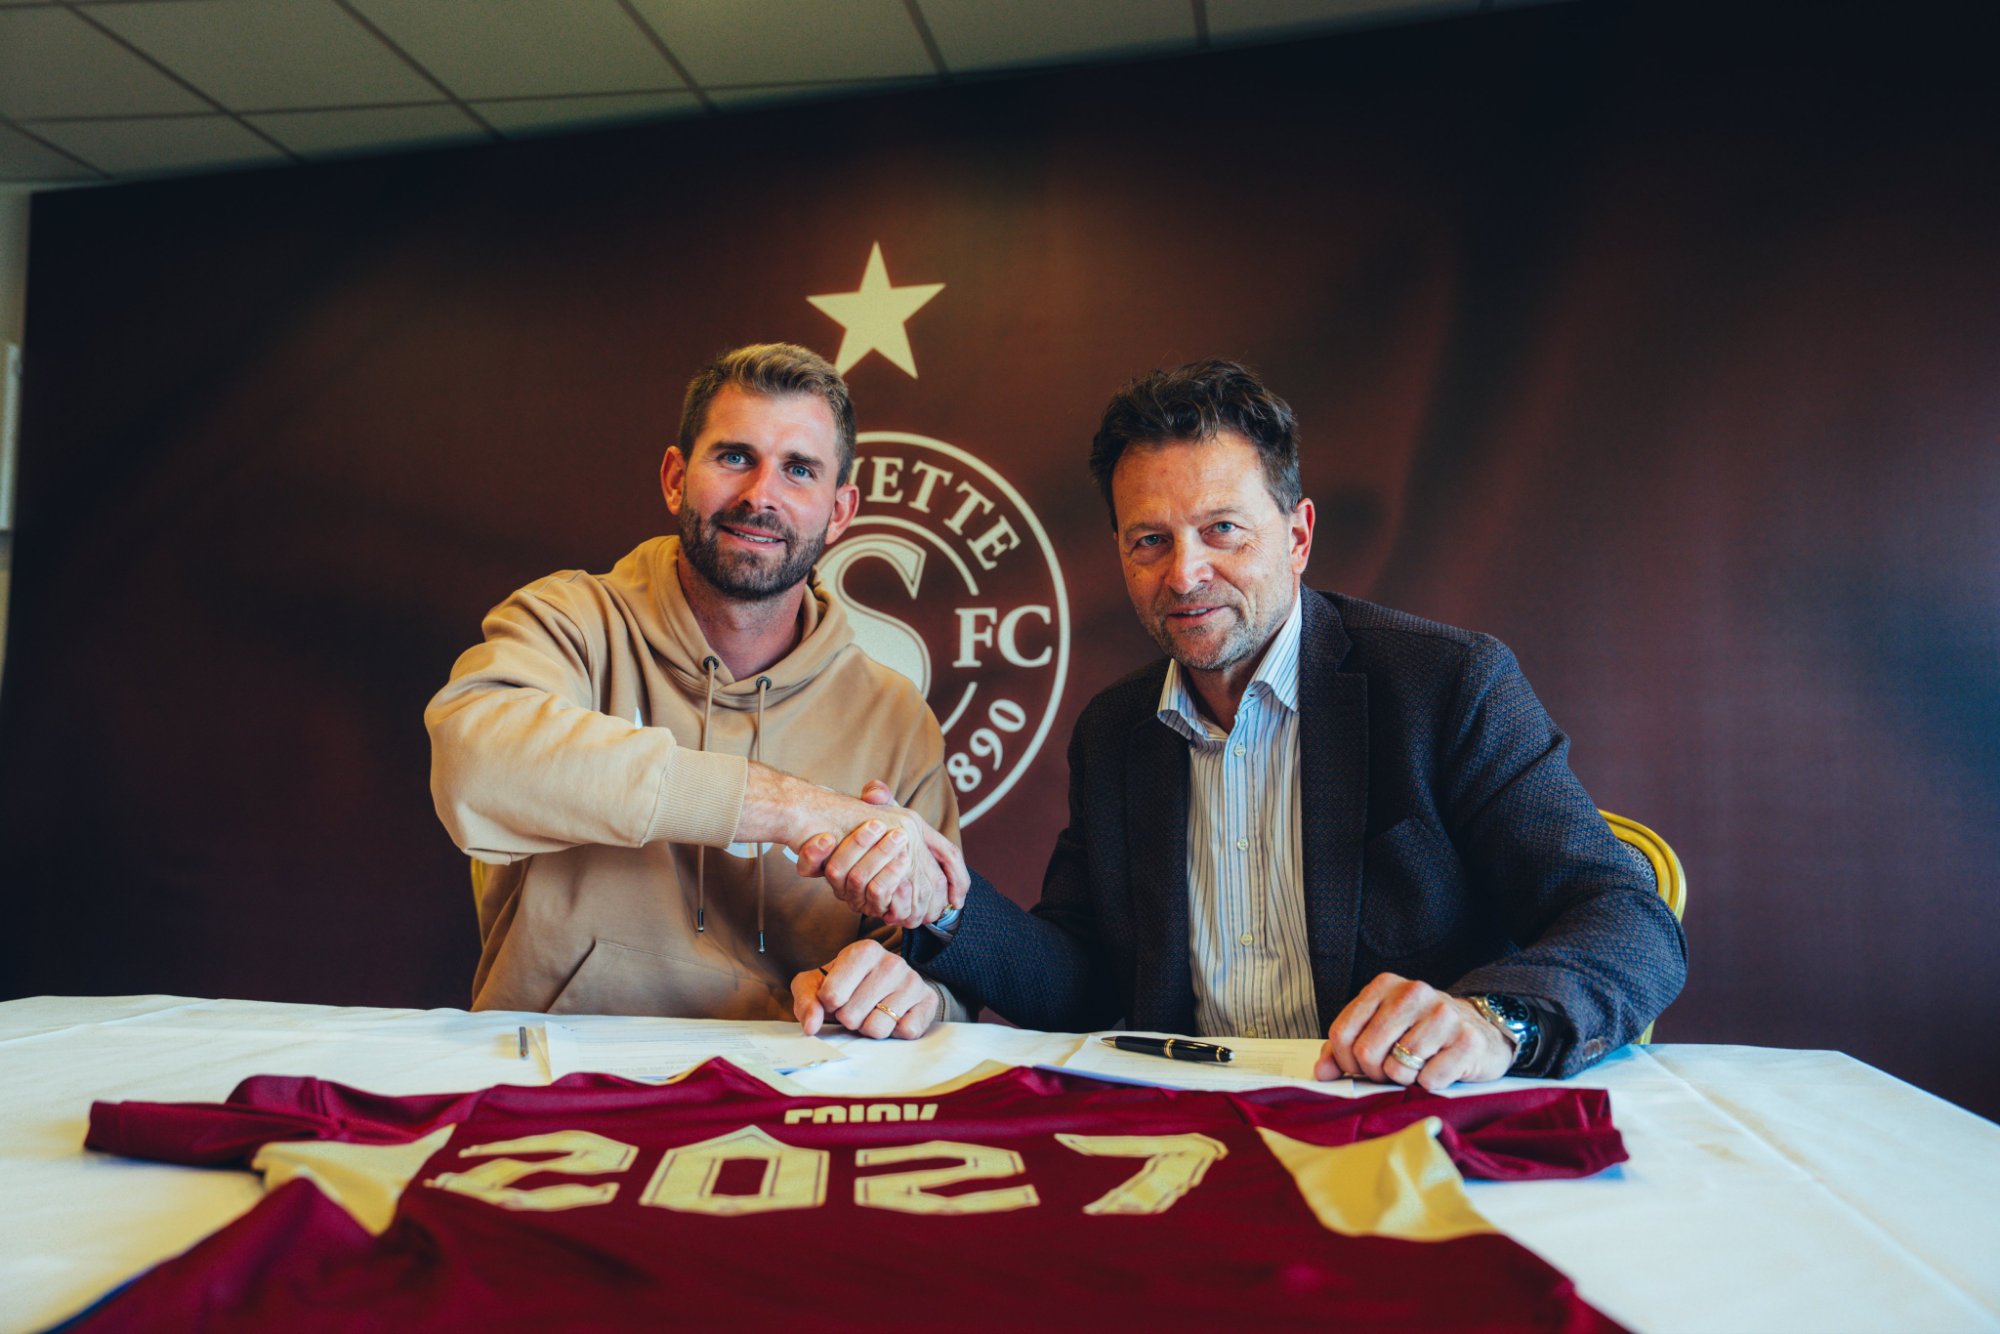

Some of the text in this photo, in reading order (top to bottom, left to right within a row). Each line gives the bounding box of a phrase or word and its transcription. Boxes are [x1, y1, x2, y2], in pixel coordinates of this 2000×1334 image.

[953, 605, 1053, 668] FC
[947, 698, 1026, 793] 890
[425, 1125, 1229, 1215] 2027
